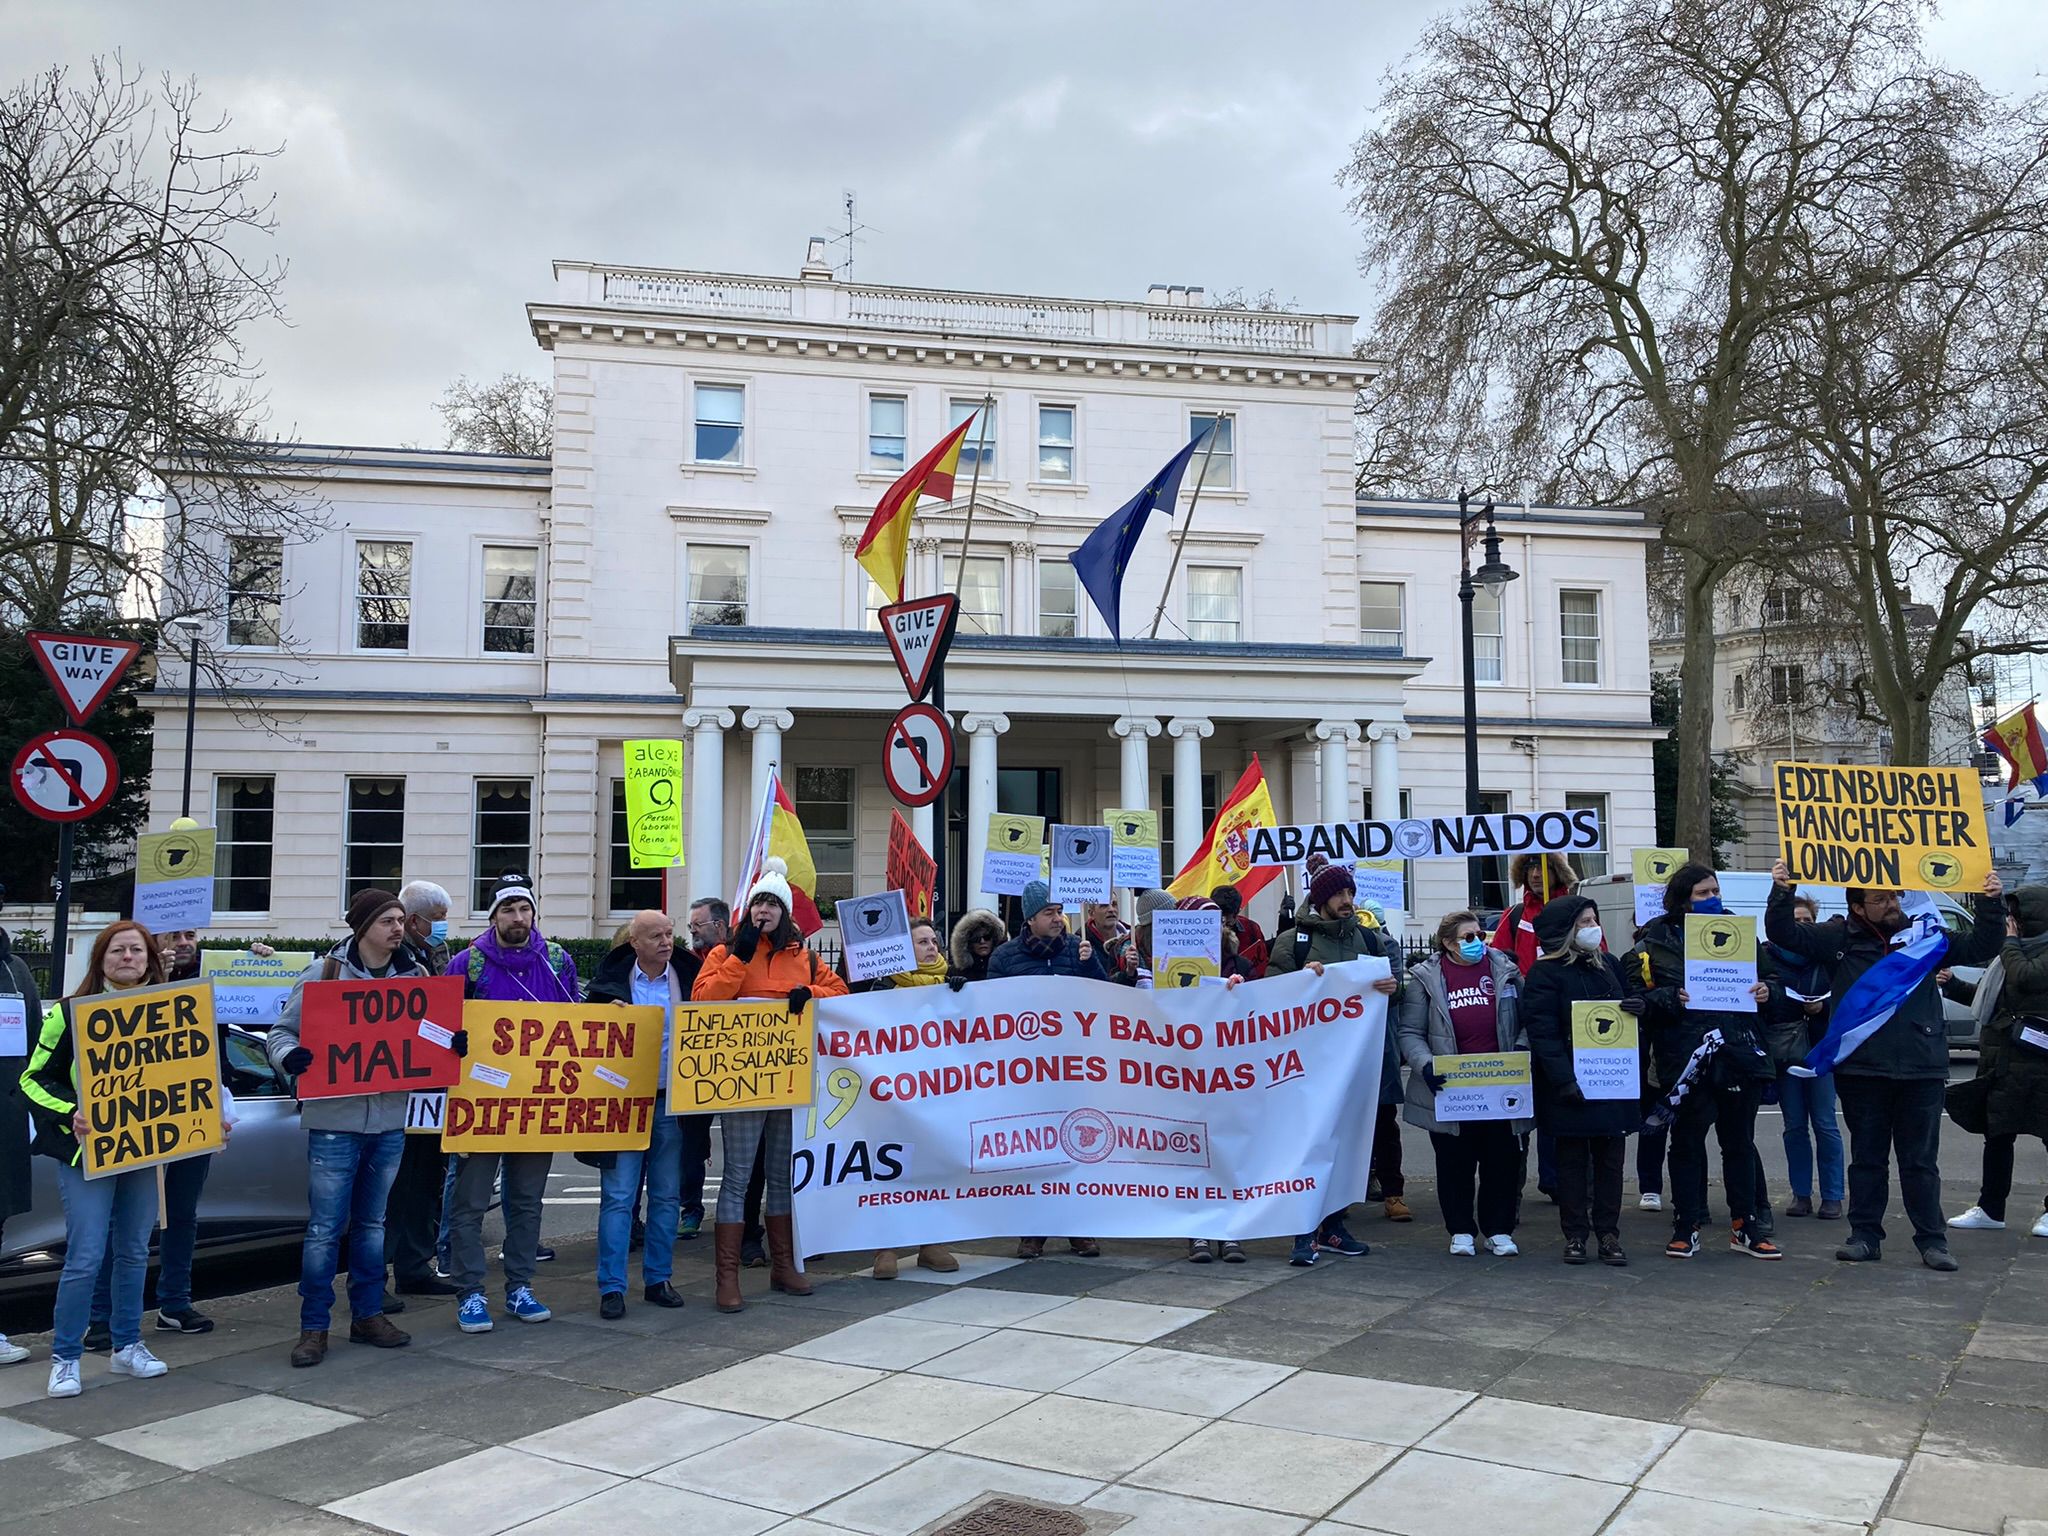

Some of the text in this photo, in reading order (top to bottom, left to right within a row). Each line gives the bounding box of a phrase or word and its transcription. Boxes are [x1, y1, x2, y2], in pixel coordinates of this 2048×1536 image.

[895, 608, 935, 633] GIVE
[903, 634, 929, 650] WAY
[53, 643, 113, 665] GIVE
[65, 666, 104, 681] WAY
[1777, 766, 1961, 807] EDINBURGH
[1780, 803, 1977, 847] MANCHESTER
[1784, 841, 1901, 886] LONDON
[174, 887, 207, 896] FOREIGN
[1059, 877, 1103, 885] TRABAJAMOS
[1078, 886, 1103, 894] ESPAÑA
[1158, 917, 1214, 925] MINISTERIO DE
[1162, 928, 1210, 936] ABANDONO
[856, 943, 904, 959] TRABAJAMOS
[857, 952, 906, 970] PARA ESPAÑA
[231, 959, 283, 968] ¡ESTAMOS
[862, 964, 904, 980] SIN ESPAÑA
[1448, 987, 1482, 1000] MAREA
[216, 1006, 243, 1014] GNOS
[342, 987, 427, 1025] TODO
[86, 994, 198, 1043] OVER
[681, 1010, 789, 1032] INFLATION
[1073, 1011, 1097, 1036] Y
[1109, 1014, 1203, 1050] BAJO
[1215, 994, 1364, 1047] MÍNIMOS
[492, 1017, 636, 1058] SPAIN
[680, 1030, 796, 1051] KEEPS RISING
[86, 1029, 210, 1077] WORKED
[328, 1039, 432, 1085] MAL
[678, 1047, 808, 1079] OUR SALARIES
[1579, 1057, 1632, 1065] MINISTERIO DE
[90, 1067, 145, 1098] and
[532, 1060, 582, 1094] IS
[869, 1049, 1305, 1102] CONDICIONES DIGNAS YA
[1583, 1068, 1629, 1076] ABANDONO
[1588, 1079, 1625, 1087] EXTERIOR
[91, 1078, 213, 1133] UNDER
[1444, 1104, 1489, 1112] DIGNOS YA
[1448, 1094, 1485, 1102] SALARIOS
[408, 1095, 442, 1127] IN
[446, 1096, 655, 1137] DIFFERENT
[93, 1123, 180, 1168] PAID
[793, 1141, 903, 1194] DIAS
[858, 1177, 1316, 1207] PERSONAL LABORAL SIN CONVENIO EN EL EXTERIOR
